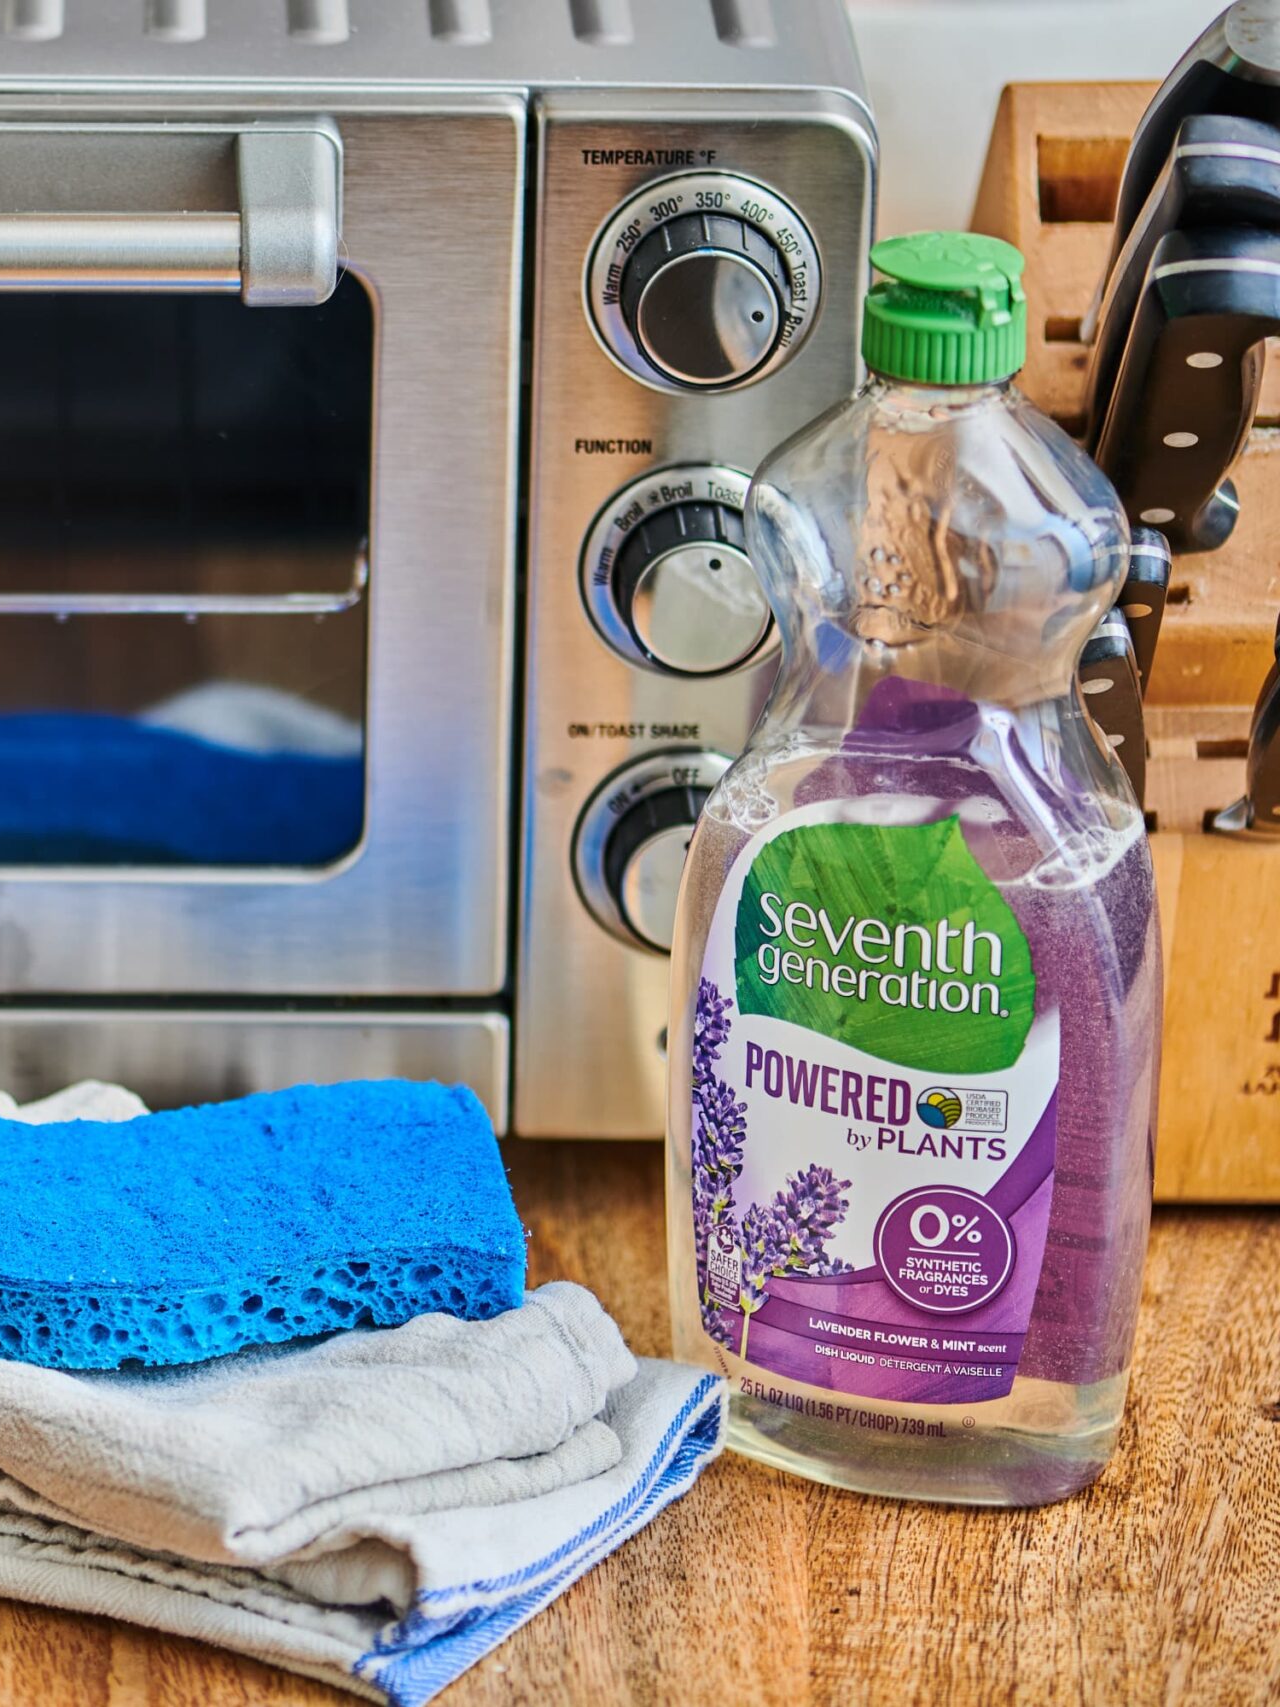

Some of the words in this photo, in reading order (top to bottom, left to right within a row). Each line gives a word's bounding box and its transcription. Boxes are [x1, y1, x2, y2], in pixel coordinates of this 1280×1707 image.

[582, 149, 694, 165] TEMPERATURE
[700, 149, 716, 165] °F
[603, 263, 622, 306] Warm
[616, 219, 642, 254] 250°
[649, 195, 684, 222] 300°
[695, 192, 731, 208] 350°
[740, 199, 774, 223] 400°
[775, 227, 802, 256] 450°
[791, 261, 808, 302] Toast
[575, 438, 653, 454] FUNCTION
[593, 545, 615, 587] Warm
[614, 502, 644, 533] Broil
[660, 481, 694, 503] Broil
[707, 481, 744, 506] Toast
[568, 723, 646, 739] ON/TOAST
[650, 723, 701, 739] SHADE
[606, 791, 629, 815] ON
[672, 768, 700, 785] OFF
[745, 1040, 912, 1127] POWERED
[846, 1128, 872, 1151] by
[877, 1127, 1007, 1161] PLANTS
[909, 1204, 982, 1247] 0%
[710, 1250, 739, 1272] SAFER
[710, 1261, 738, 1282] CHOICE
[899, 1268, 989, 1285] FRAGRANCES
[906, 1256, 982, 1273] SYNTHETIC
[919, 1285, 933, 1294] or
[934, 1284, 969, 1297] DYES
[809, 1317, 871, 1341] LAVENDER
[874, 1332, 927, 1348] FLOWER
[930, 1338, 940, 1349] &
[942, 1339, 976, 1352] MINT
[977, 1343, 1007, 1353] scent
[815, 1344, 839, 1358] DISH
[840, 1349, 876, 1365] LIQUID
[953, 1365, 1002, 1377] VAISELLE
[740, 1376, 753, 1395] 25
[755, 1382, 768, 1401] FL
[769, 1387, 784, 1406] OZ
[785, 1392, 804, 1413] LIQ
[805, 1398, 833, 1420] (1.56
[901, 1417, 924, 1436] 739
[927, 1421, 947, 1438] mL
